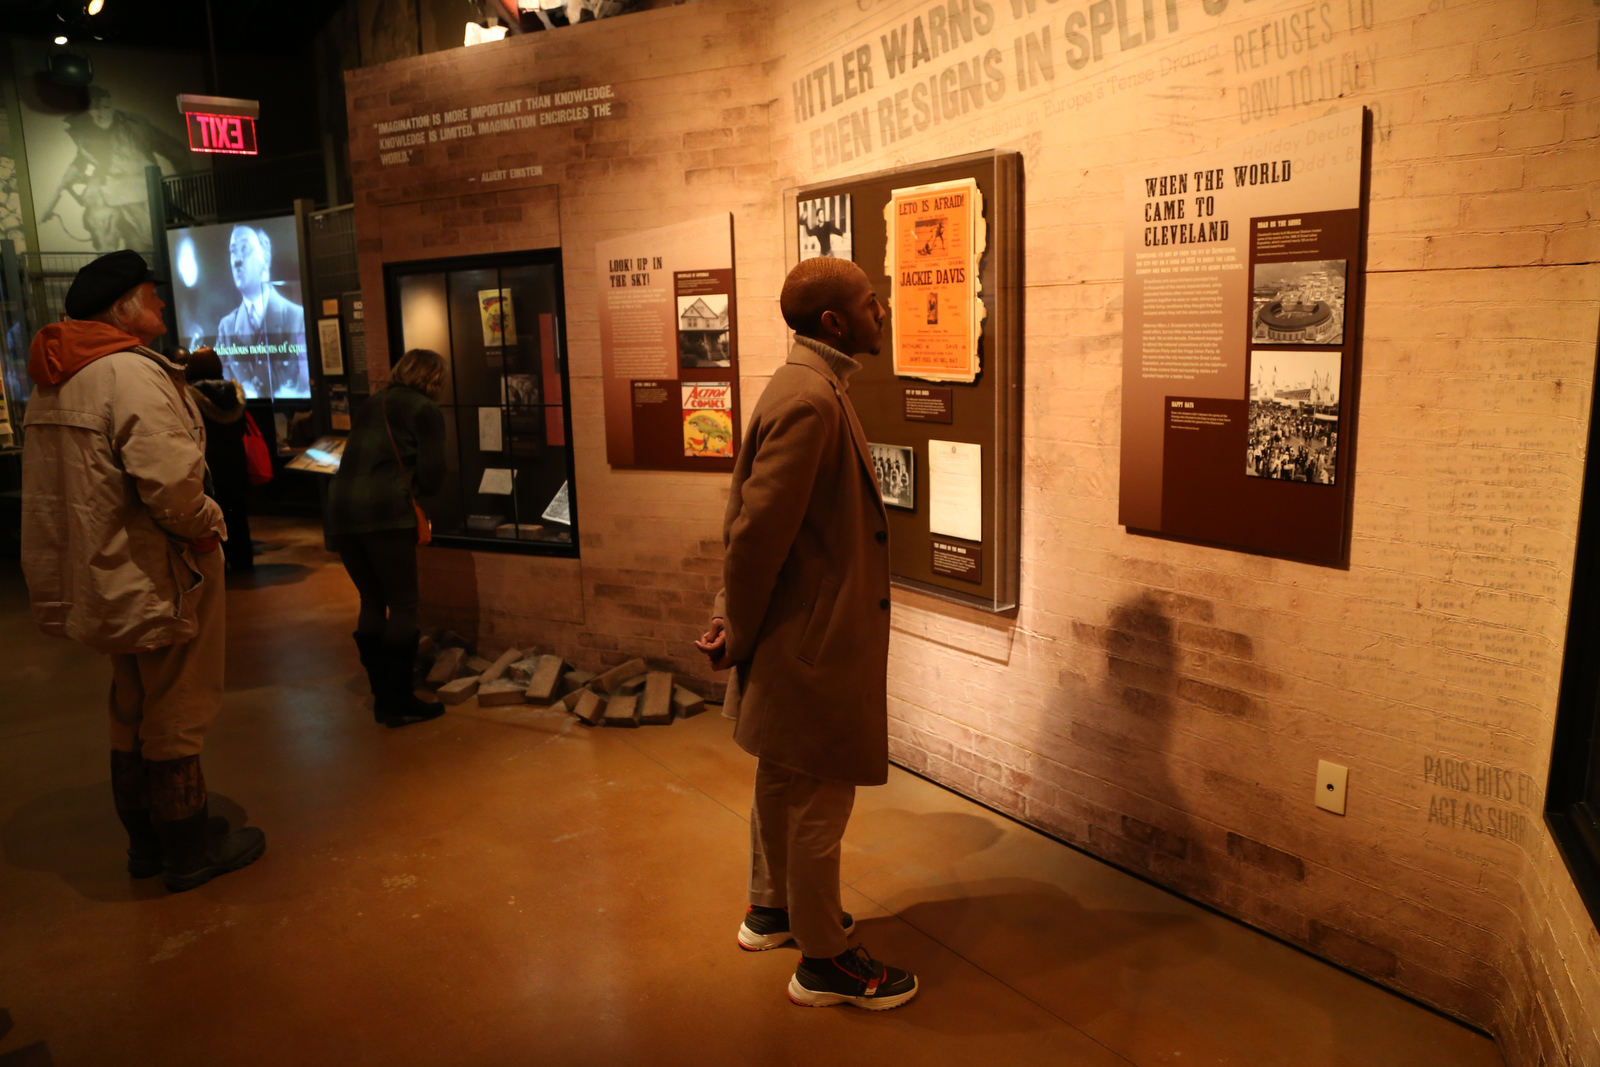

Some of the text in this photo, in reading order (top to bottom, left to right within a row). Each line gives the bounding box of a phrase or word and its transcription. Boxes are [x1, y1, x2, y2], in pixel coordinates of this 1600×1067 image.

[1233, 2, 1334, 74] REFUSES
[792, 0, 995, 124] HITLER WARNS
[810, 0, 1180, 175] EDEN RESIGNS IN SPLIT
[1042, 82, 1105, 118] Europe's
[1108, 68, 1156, 96] Tense
[1159, 43, 1220, 77] Drama
[1238, 42, 1378, 125] BOW TO ITALY
[432, 114, 441, 125] IS
[444, 109, 468, 124] MORE
[471, 100, 522, 120] IMPORTANT
[527, 95, 551, 110] THAN
[554, 85, 615, 106] KNOWLEDGE.
[379, 103, 611, 150] KNOWLEDGE IS LIMITED. IMAGINATION ENCIRCLES THE
[481, 165, 543, 183] ALBERT EINSTEIN
[1145, 160, 1291, 198] WHEN THE WORLD
[899, 202, 918, 216] LETO
[922, 200, 929, 212] IS
[934, 194, 965, 211] AFRAID!
[1145, 196, 1214, 223] CAME TO
[1145, 220, 1229, 247] CLEVELAND
[609, 257, 663, 273] LOOK! UP IN
[610, 273, 650, 288] THE SKY!
[900, 268, 965, 287] JACKIE DAVIS
[278, 341, 288, 353] of
[686, 384, 728, 403] ACTION
[690, 400, 725, 408] COMICS
[1424, 755, 1471, 793] PARIS
[1475, 762, 1513, 802] HITS
[1428, 795, 1457, 827] ACT
[1462, 802, 1484, 834] AS
